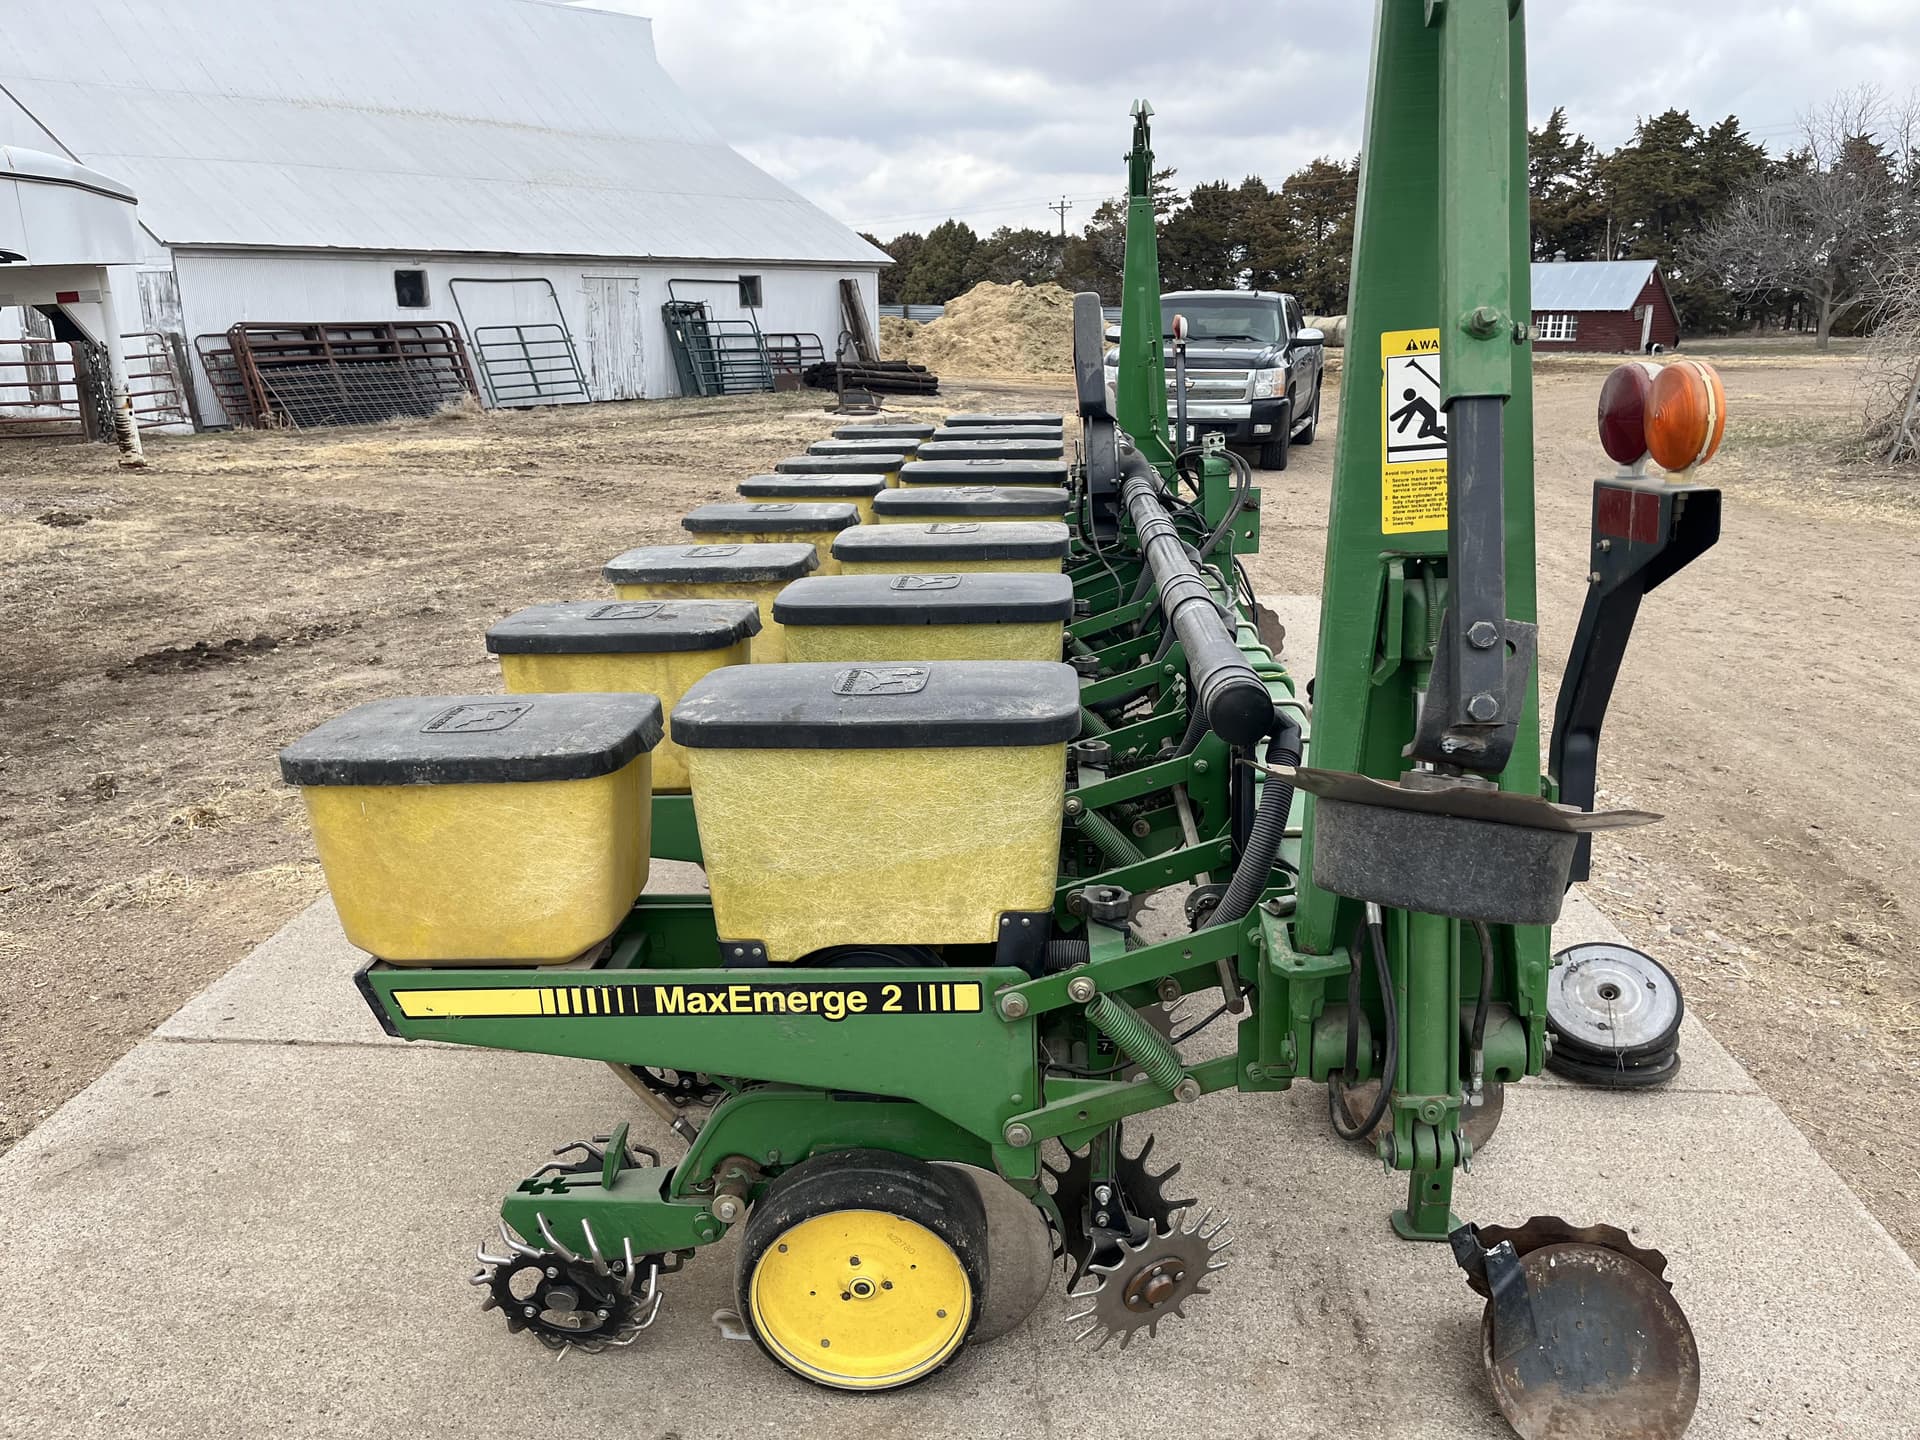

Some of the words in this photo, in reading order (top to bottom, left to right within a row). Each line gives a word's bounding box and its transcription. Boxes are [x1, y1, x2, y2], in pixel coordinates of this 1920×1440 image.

[654, 986, 868, 1018] MaxEmerge
[881, 984, 902, 1011] 2
[1101, 1042, 1108, 1051] 7
